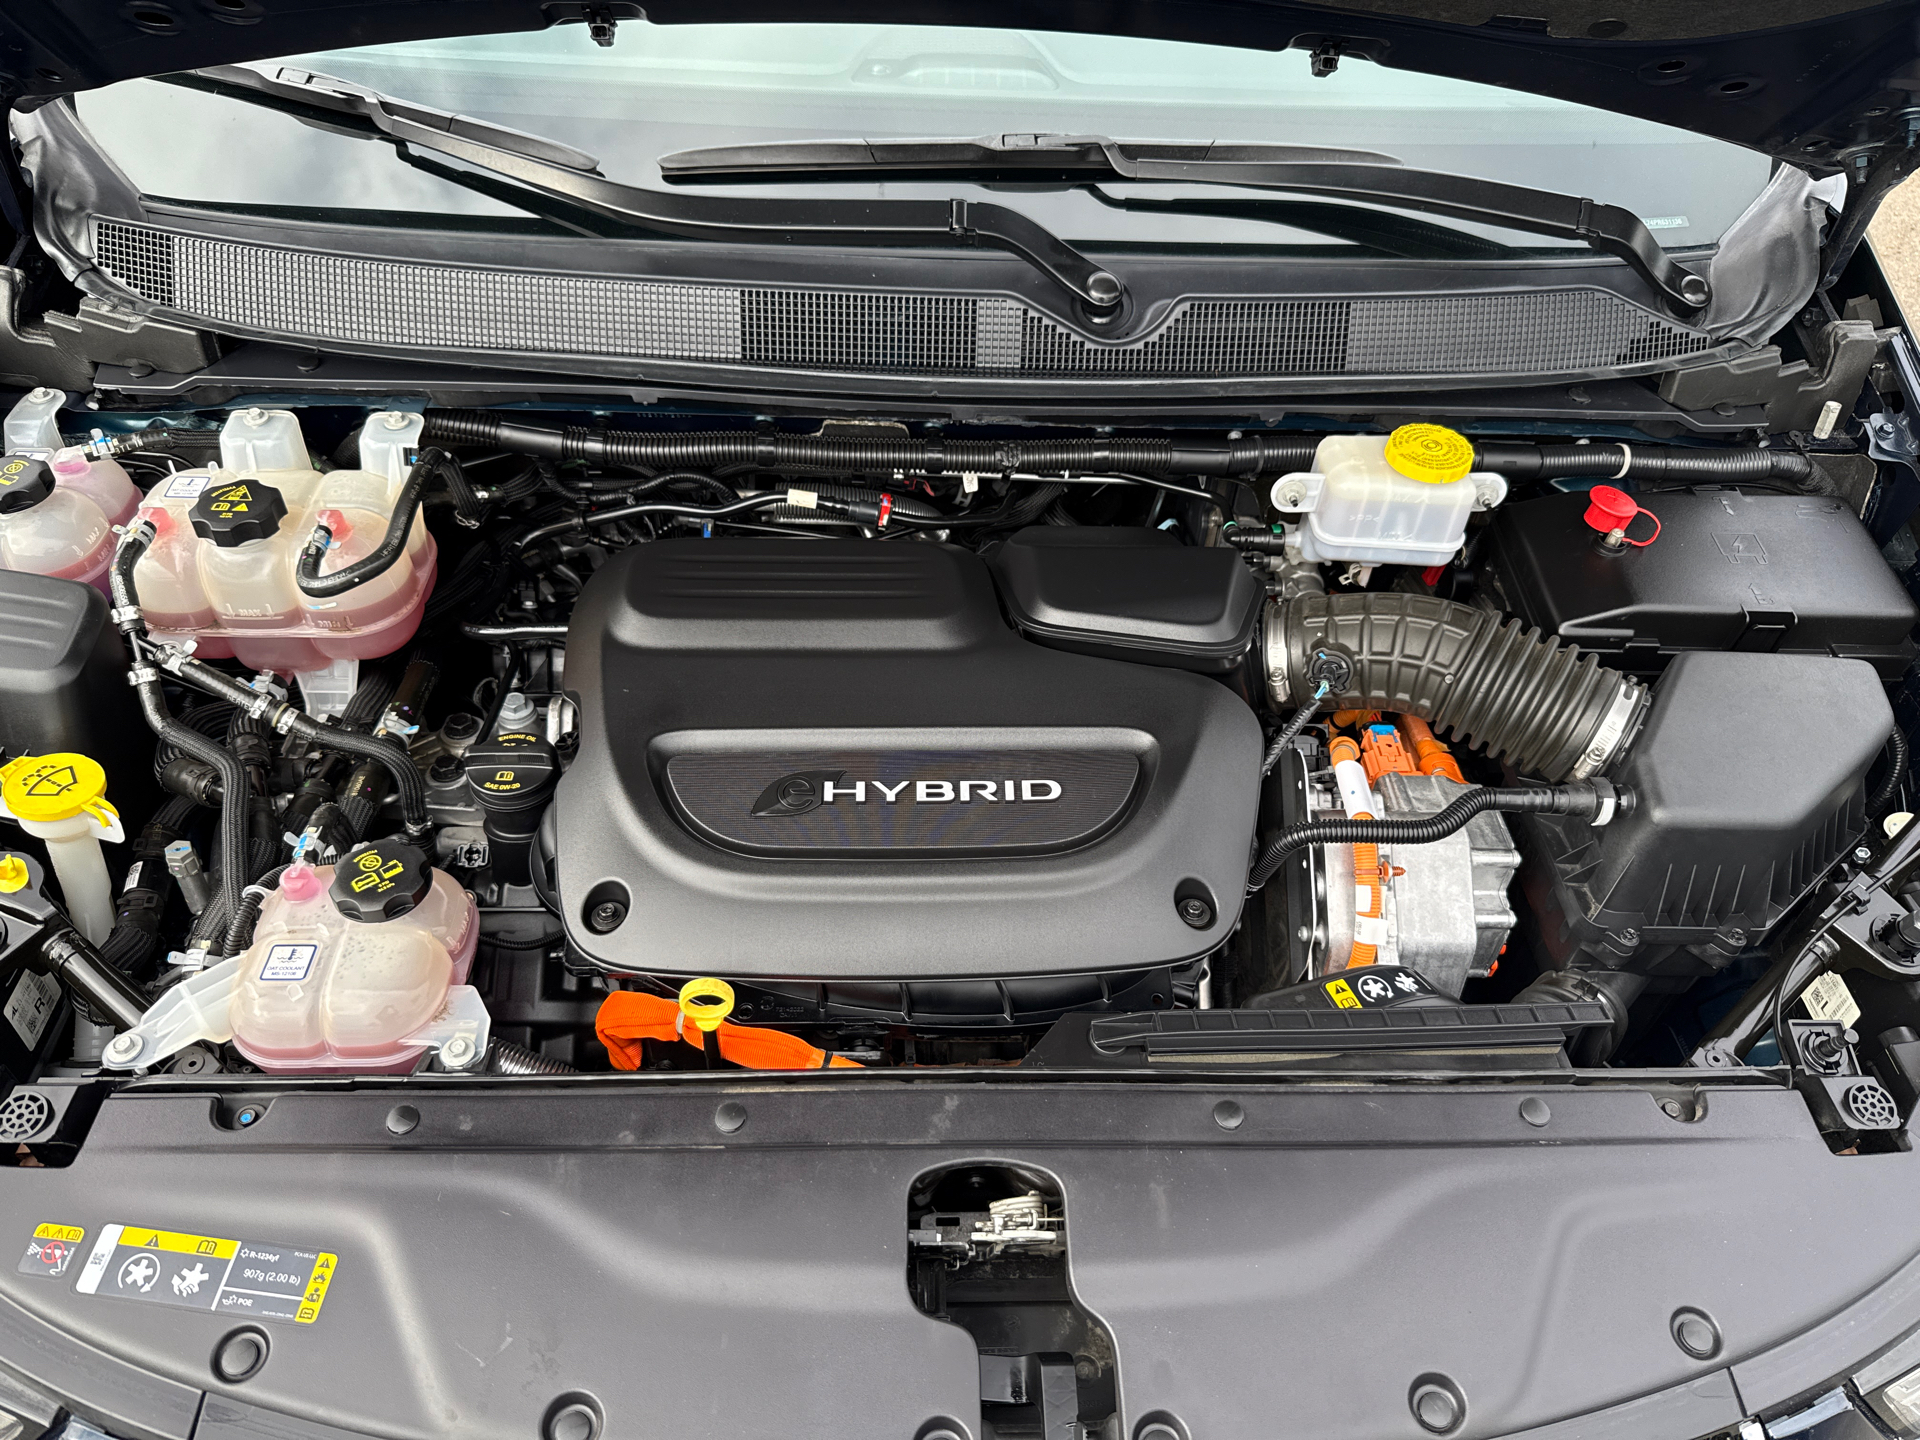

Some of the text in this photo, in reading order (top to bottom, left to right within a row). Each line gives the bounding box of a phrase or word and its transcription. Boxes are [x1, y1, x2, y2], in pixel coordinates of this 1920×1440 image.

[497, 734, 526, 742] ENGINE
[484, 781, 521, 791] SAE 0W-20
[823, 779, 1063, 802] HYBRID
[34, 996, 46, 1015] R
[1820, 1000, 1829, 1017] L
[249, 1250, 280, 1263] R-1234yf
[243, 1268, 301, 1286] 907g (2.00 lb)
[237, 1298, 254, 1307] POE
